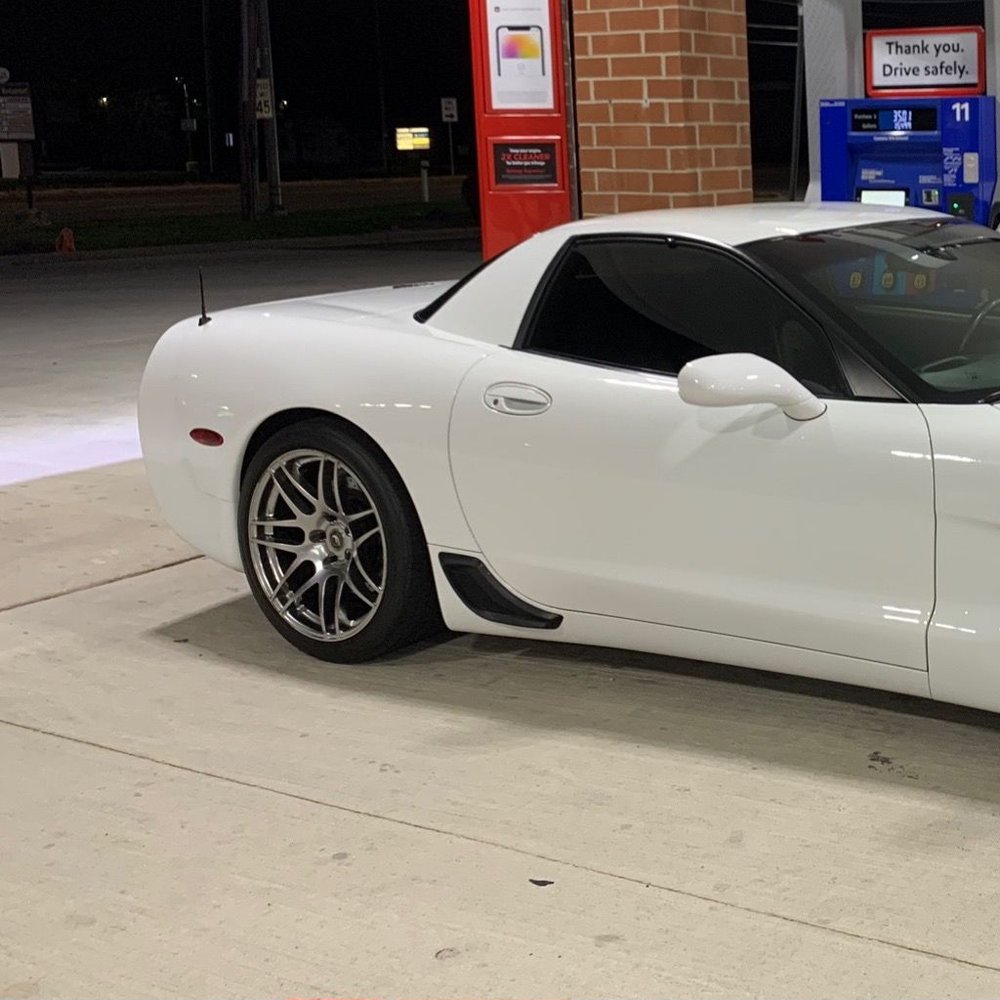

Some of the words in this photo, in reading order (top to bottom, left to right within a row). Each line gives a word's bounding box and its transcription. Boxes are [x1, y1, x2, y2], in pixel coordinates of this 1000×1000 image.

[886, 40, 929, 55] Thank
[934, 42, 965, 57] you.
[883, 62, 920, 77] Drive
[924, 61, 969, 79] safely.
[952, 102, 969, 121] 11
